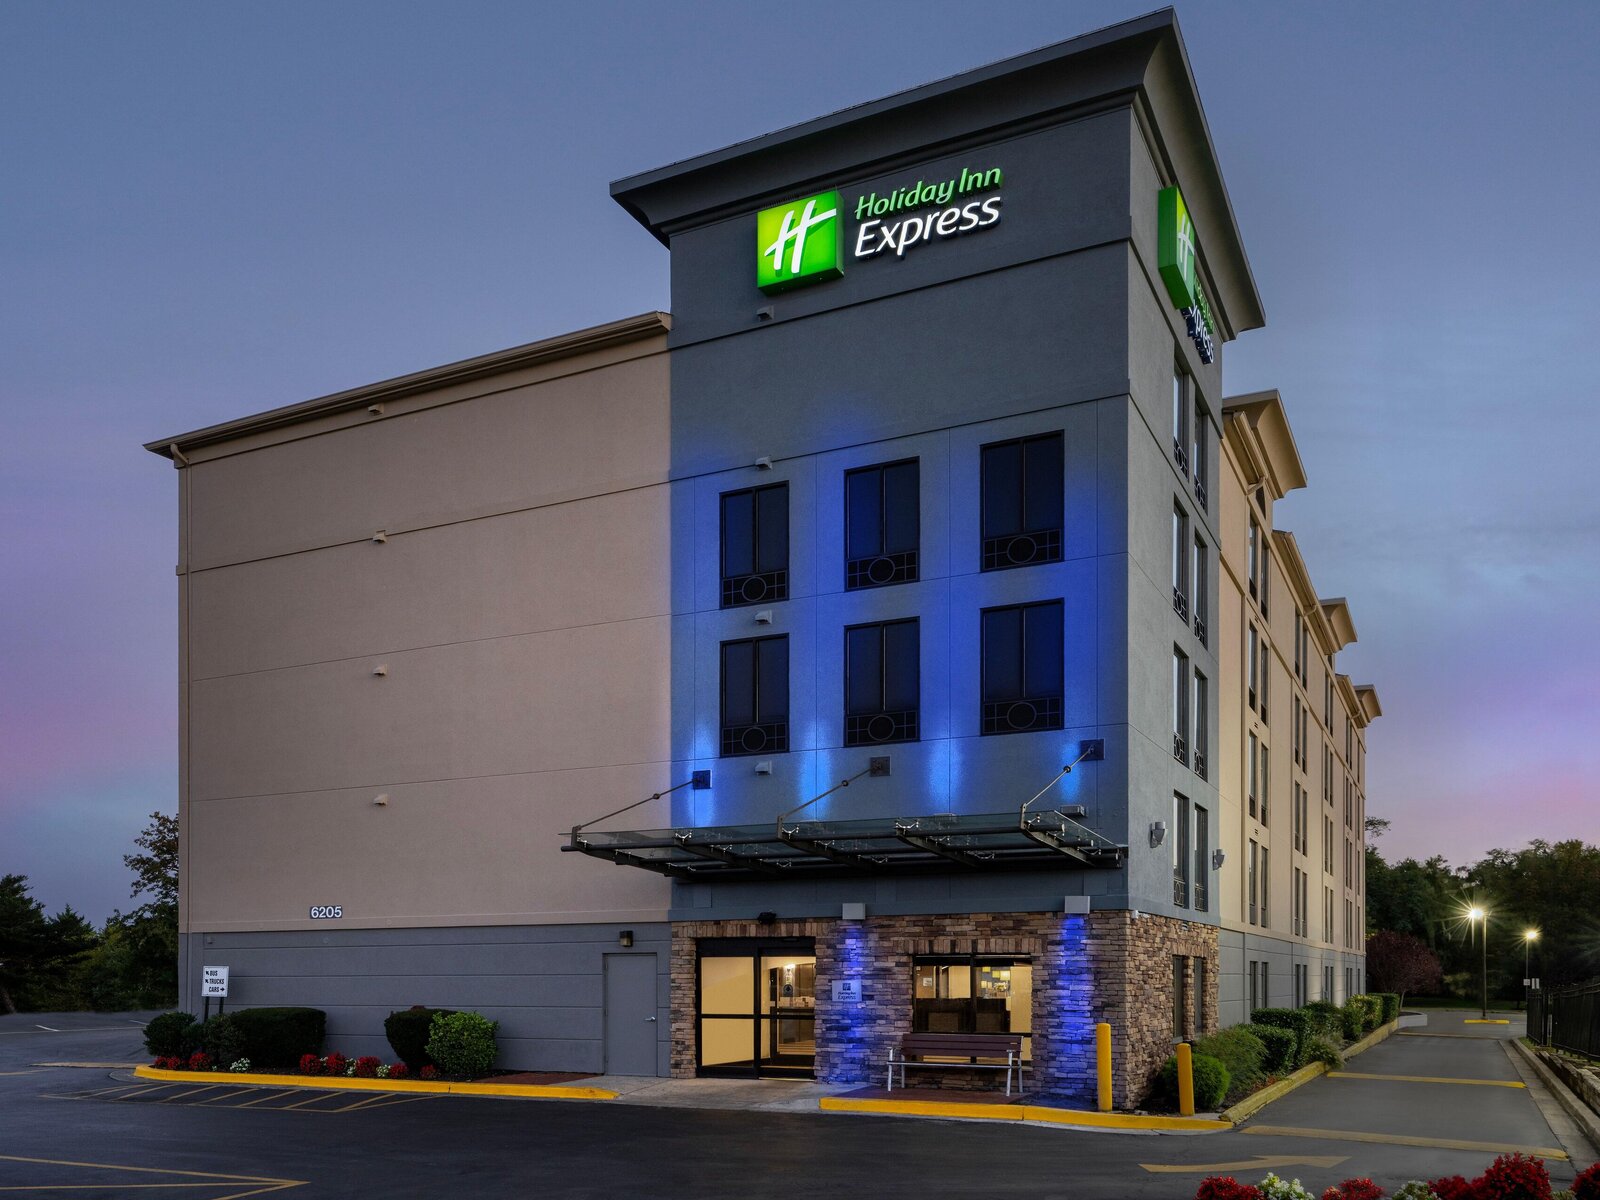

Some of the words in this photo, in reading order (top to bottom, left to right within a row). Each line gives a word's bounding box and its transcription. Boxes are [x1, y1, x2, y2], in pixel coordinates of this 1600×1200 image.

[855, 180, 955, 220] Holiday
[958, 167, 1001, 193] Inn
[854, 196, 1001, 257] Express
[1188, 300, 1214, 364] xpress
[310, 906, 342, 919] 6205
